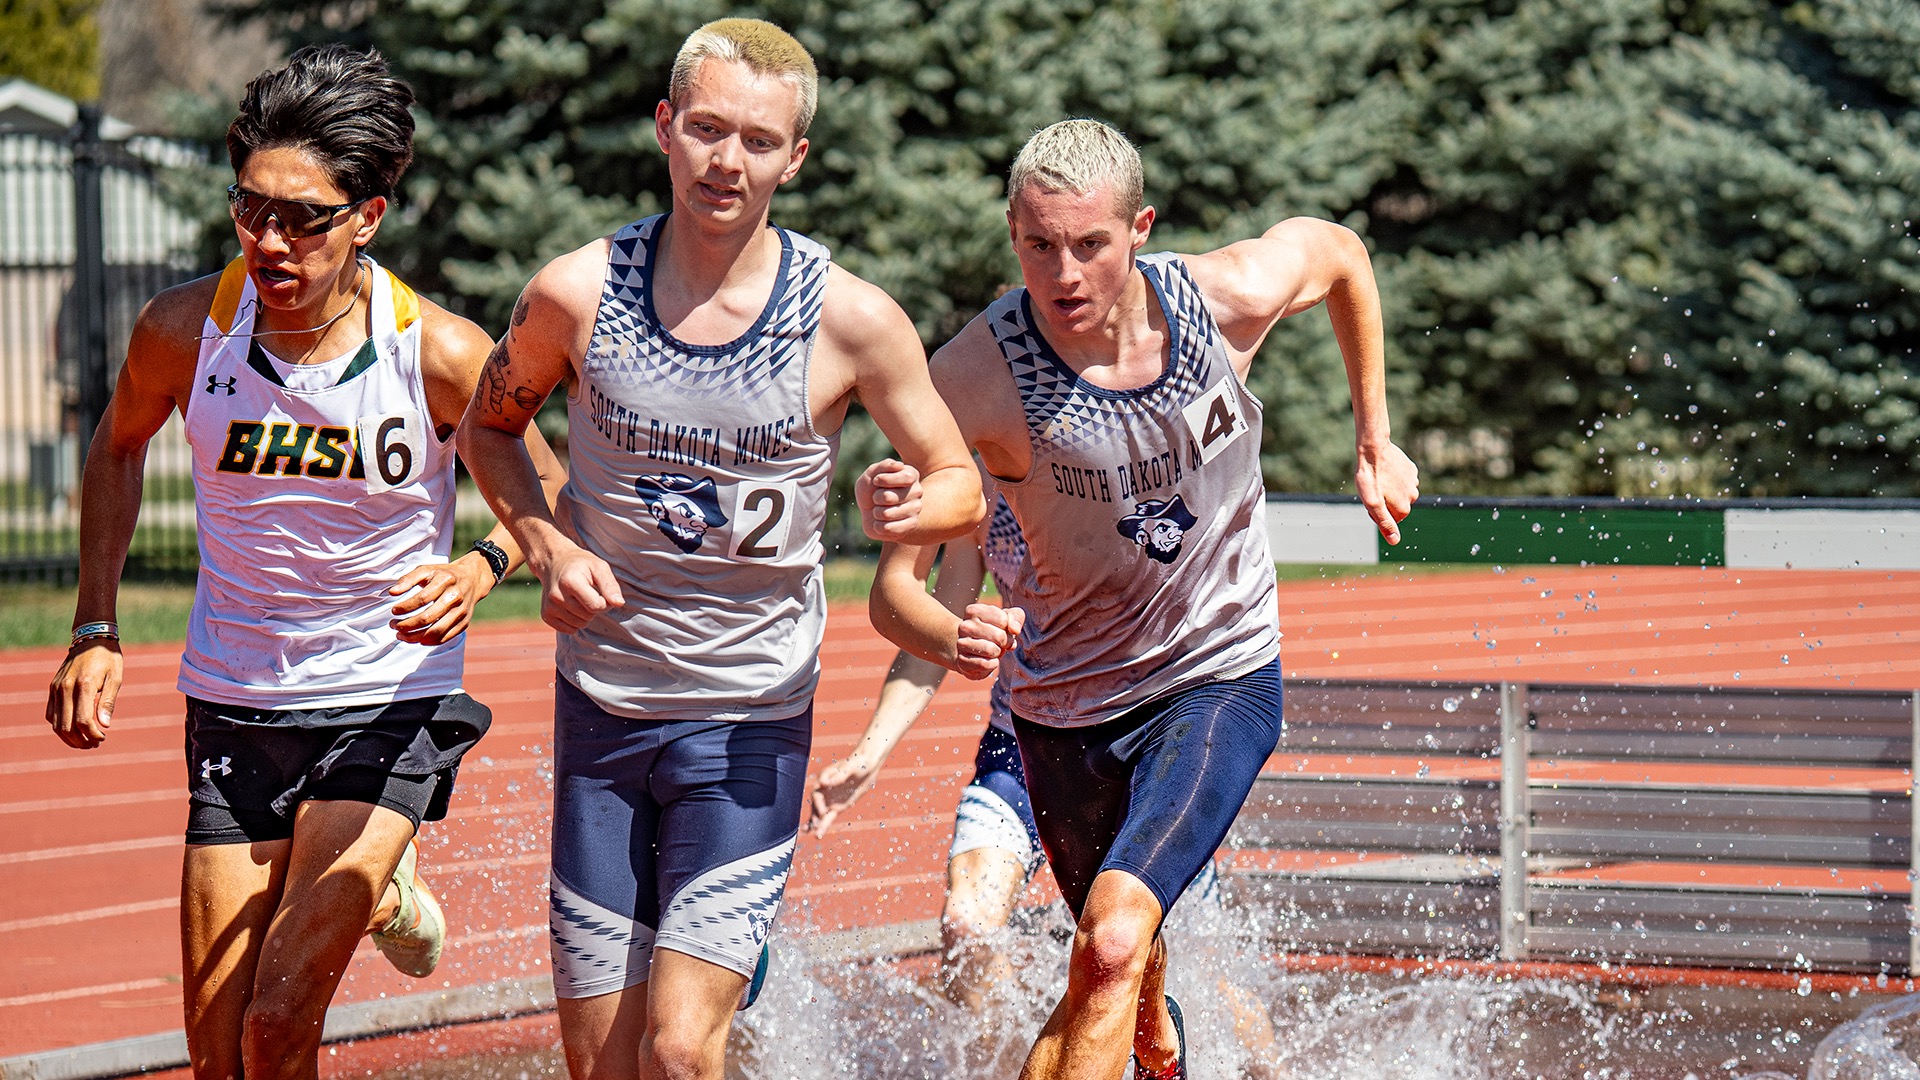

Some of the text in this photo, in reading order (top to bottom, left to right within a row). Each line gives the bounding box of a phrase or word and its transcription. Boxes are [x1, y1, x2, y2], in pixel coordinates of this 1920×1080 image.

[376, 417, 412, 486] 6
[590, 385, 795, 467] SOUTH DAKOTA MINES
[1201, 394, 1236, 449] 4
[1051, 462, 1112, 503] SOUTH
[1117, 448, 1183, 499] DAKOTA
[736, 488, 785, 558] 2
